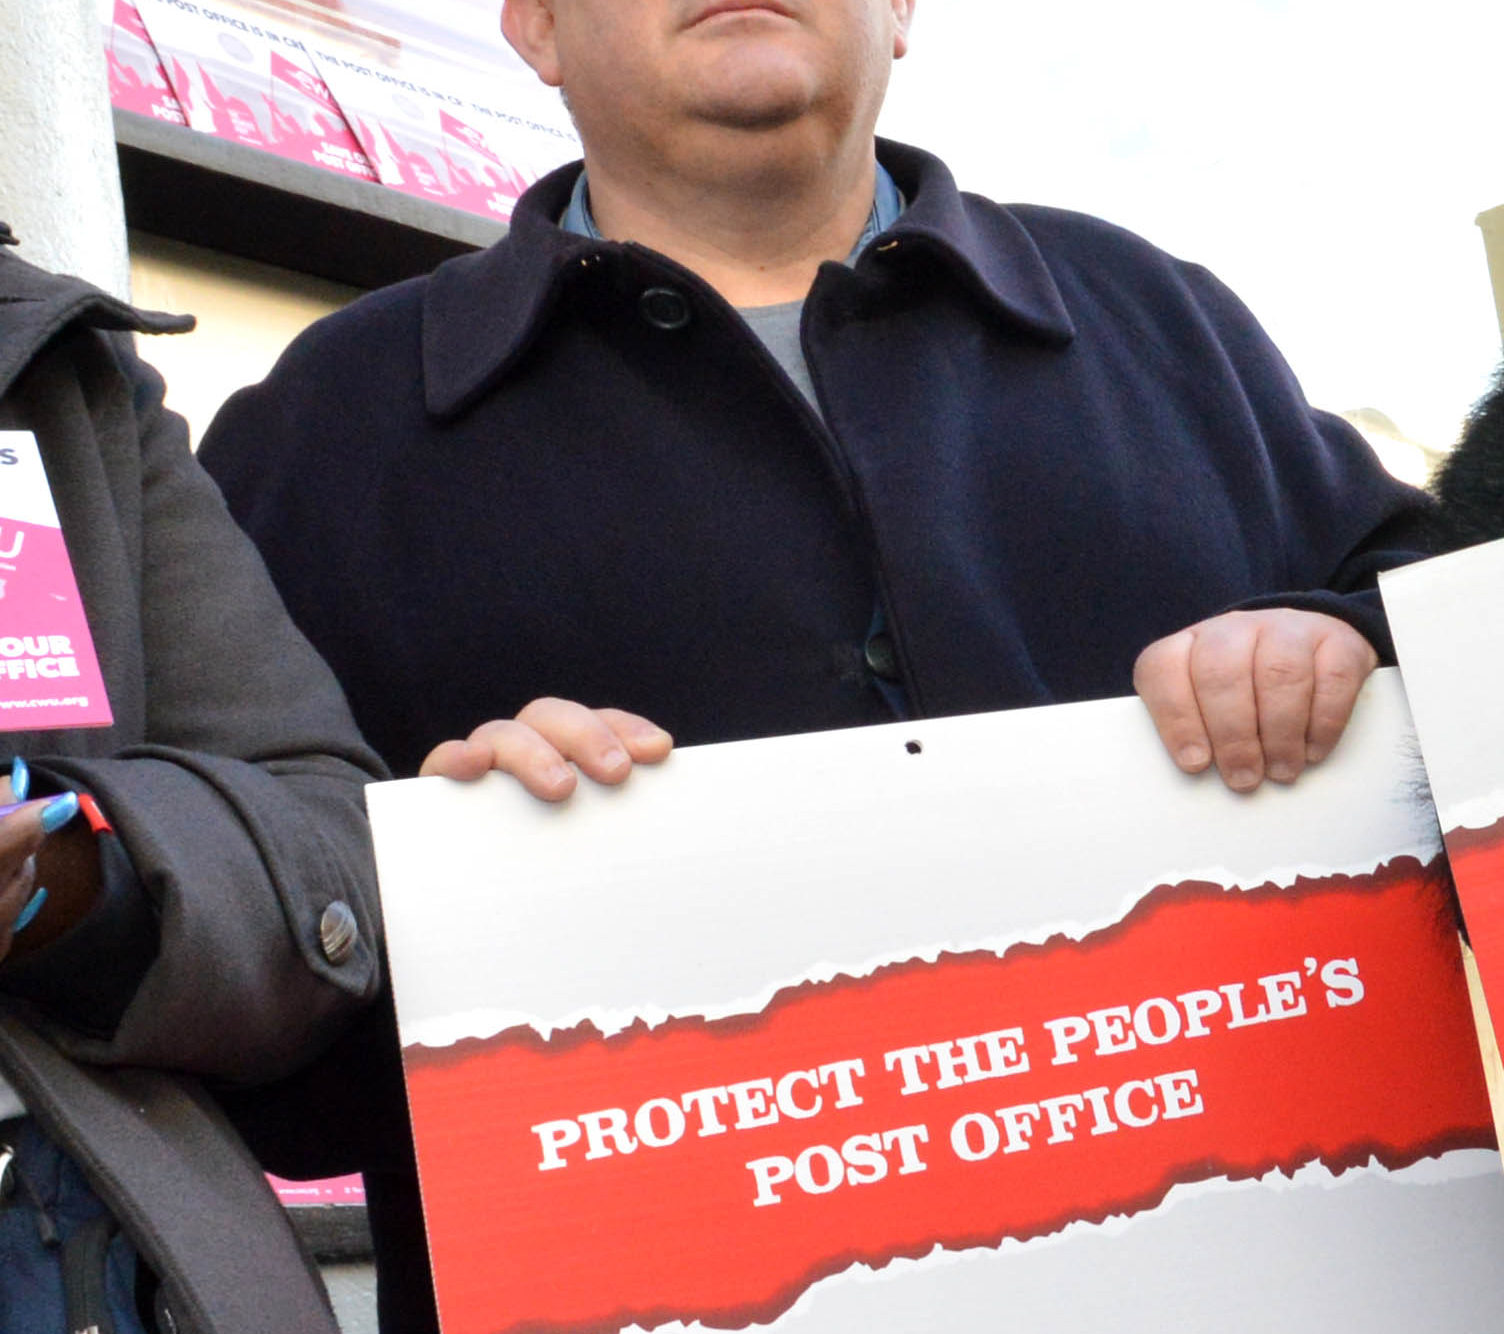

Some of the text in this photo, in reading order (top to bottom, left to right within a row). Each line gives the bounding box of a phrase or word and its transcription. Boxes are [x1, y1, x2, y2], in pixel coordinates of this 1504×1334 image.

[531, 956, 1366, 1172] PROTECT THE PEOPLE'S
[746, 1069, 1205, 1206] POST OFFICE
